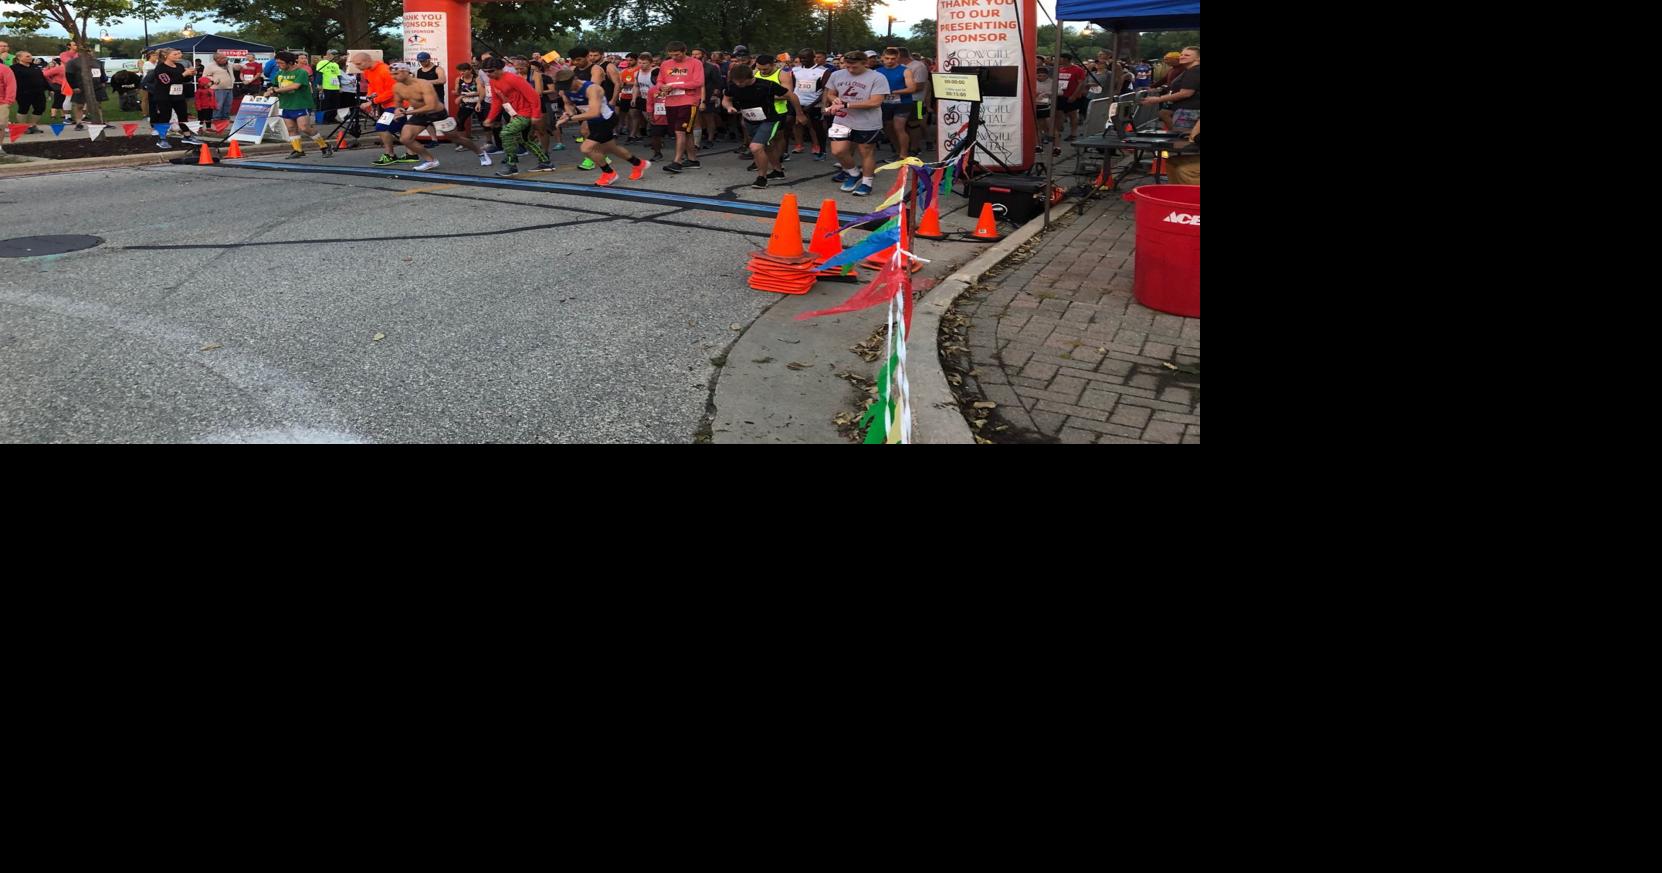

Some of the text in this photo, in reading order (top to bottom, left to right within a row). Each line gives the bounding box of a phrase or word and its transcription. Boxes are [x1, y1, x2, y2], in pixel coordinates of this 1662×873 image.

[941, 0, 980, 8] THANK
[950, 9, 1000, 19] TO OUR
[940, 21, 1017, 32] PRESENTING
[944, 33, 1008, 43] SPONSOR
[957, 49, 1010, 59] COWGILL
[1163, 211, 1200, 226] ACE
